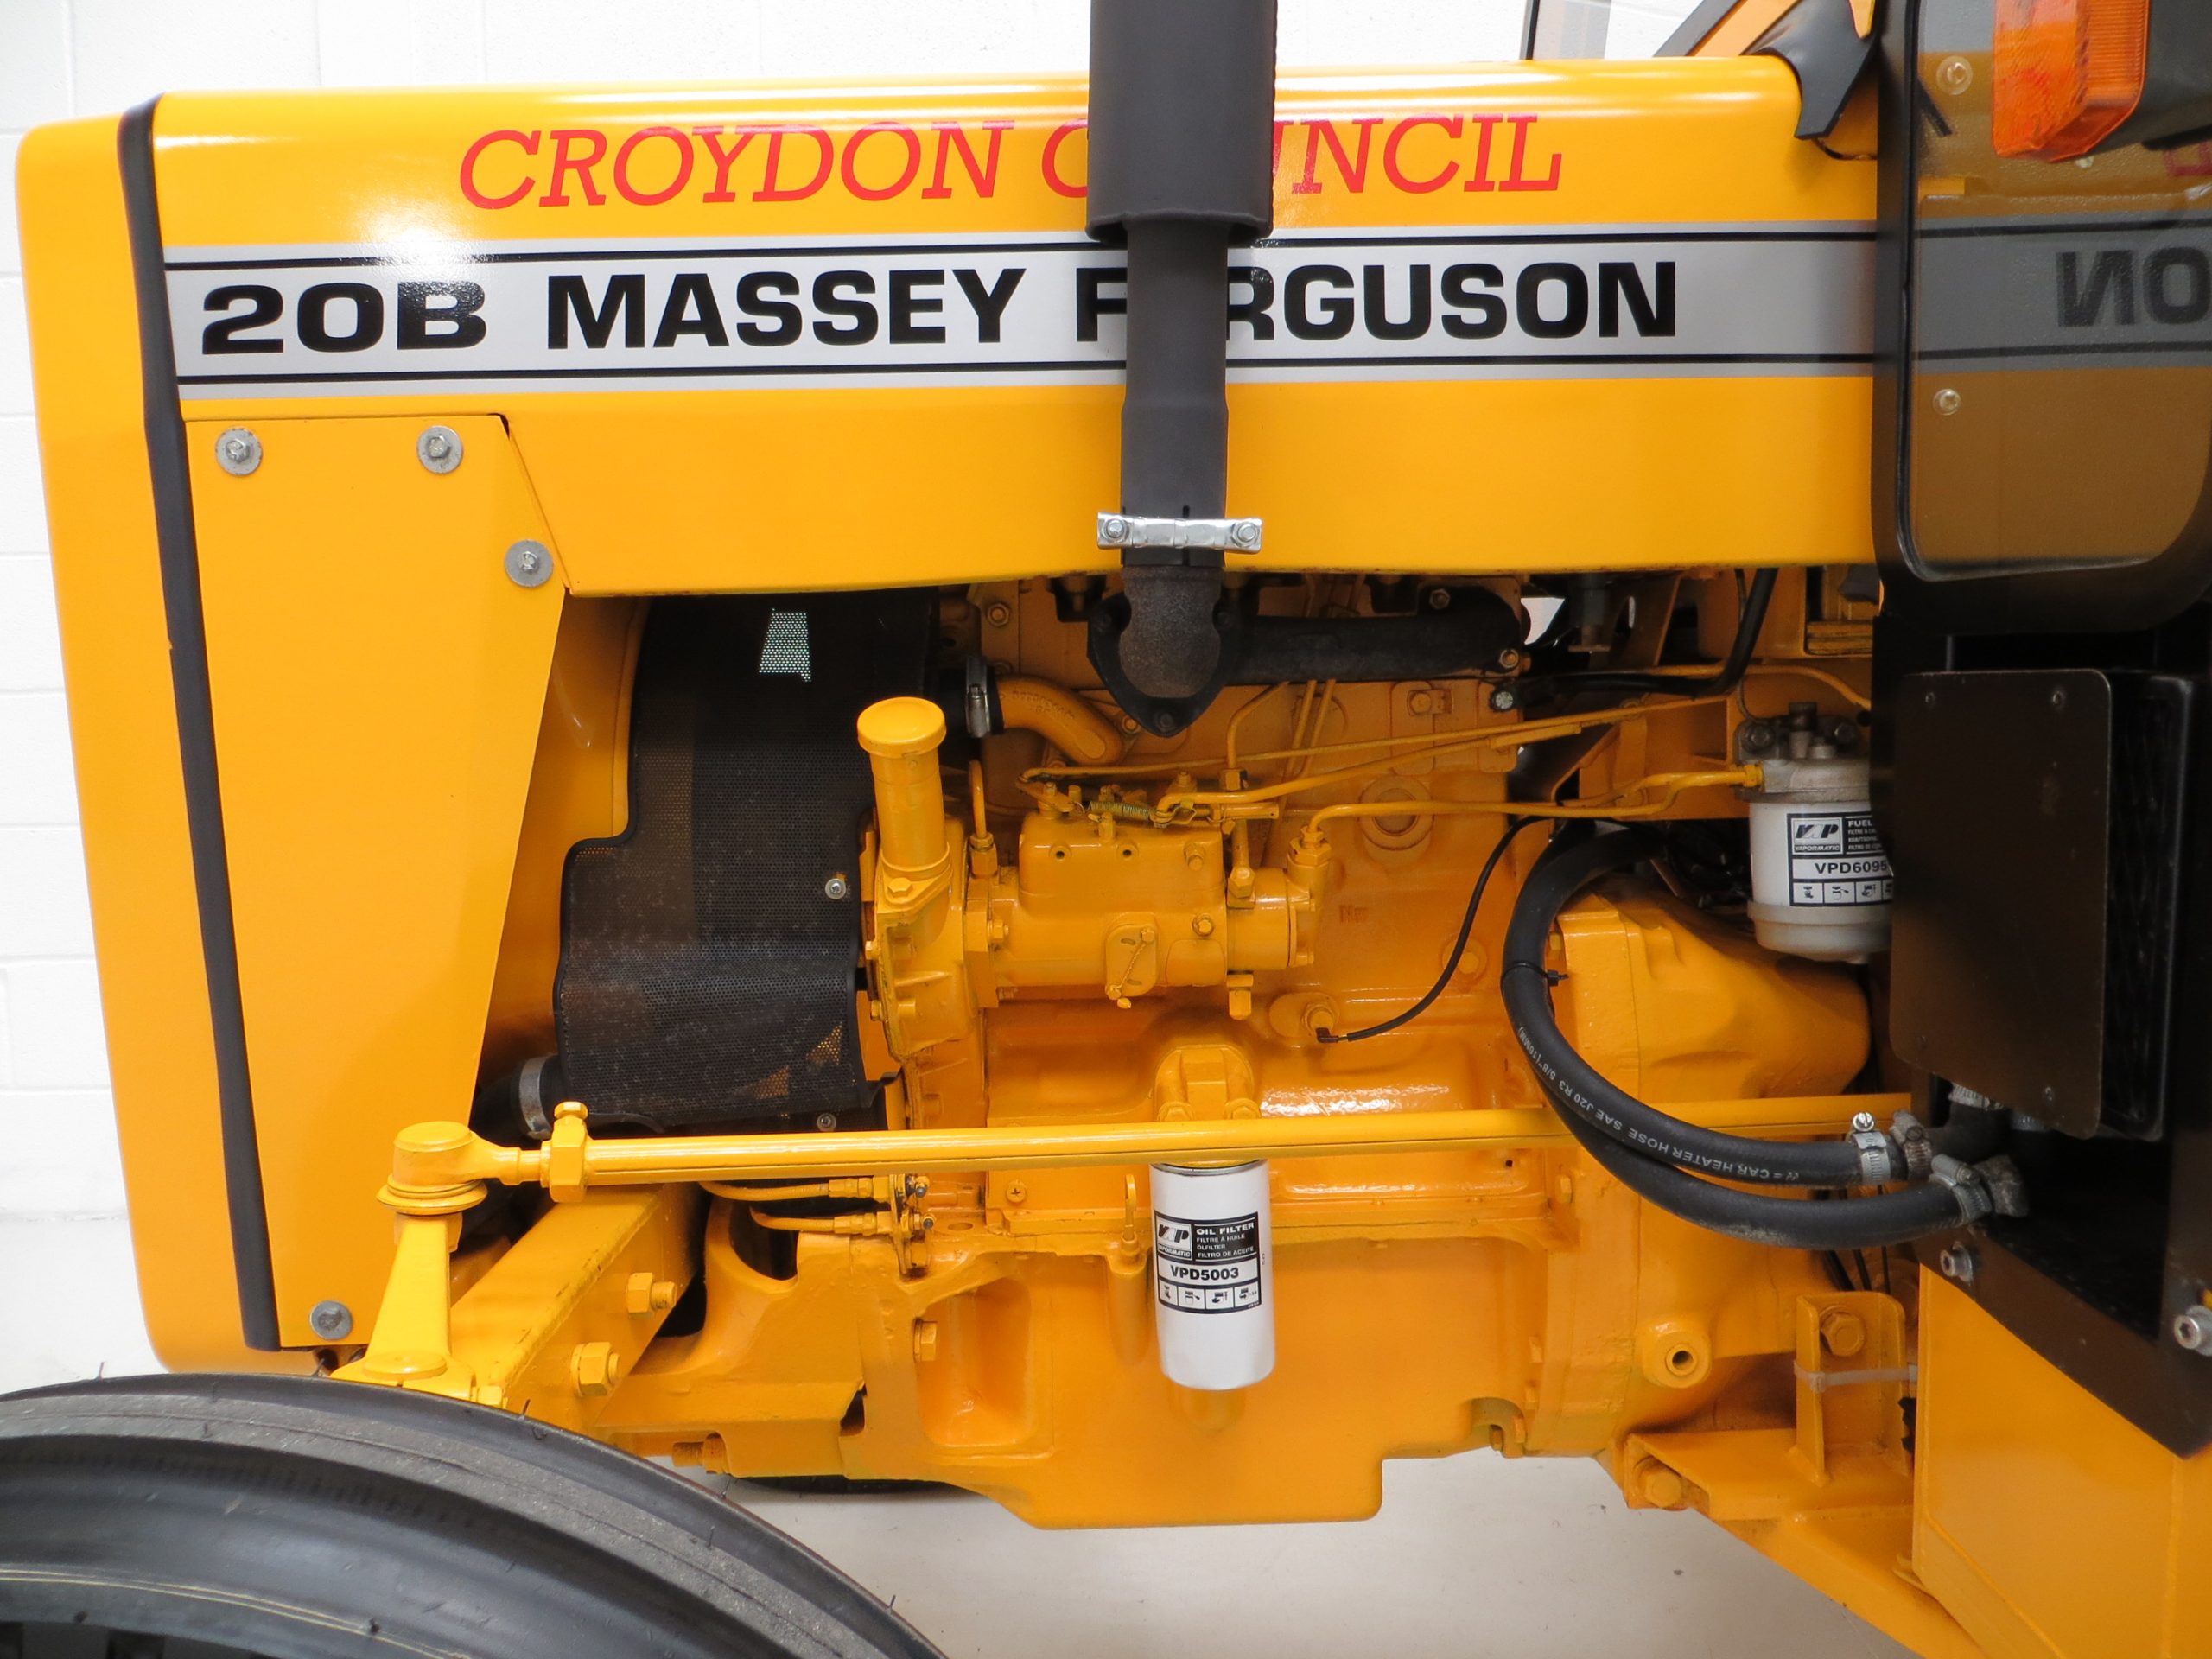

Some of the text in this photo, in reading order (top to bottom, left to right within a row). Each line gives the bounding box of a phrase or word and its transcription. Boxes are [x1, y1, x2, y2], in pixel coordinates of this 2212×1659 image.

[460, 113, 1562, 210] CROYDON CNCIL
[201, 261, 1676, 355] 20B MASSEY FRGUSON
[1559, 1080, 1573, 1097] R3
[1573, 1093, 1595, 1111] J20
[1595, 1109, 1623, 1131] SAE
[1627, 1128, 1669, 1154] HOSE
[1672, 1147, 1733, 1173] HEATER
[1737, 1161, 1770, 1179] CAR
[1219, 1222, 1255, 1235] FILTER
[1226, 1233, 1246, 1242] HUILE
[1233, 1245, 1255, 1255] ACEITE
[1170, 1265, 1240, 1281] VPD5003
